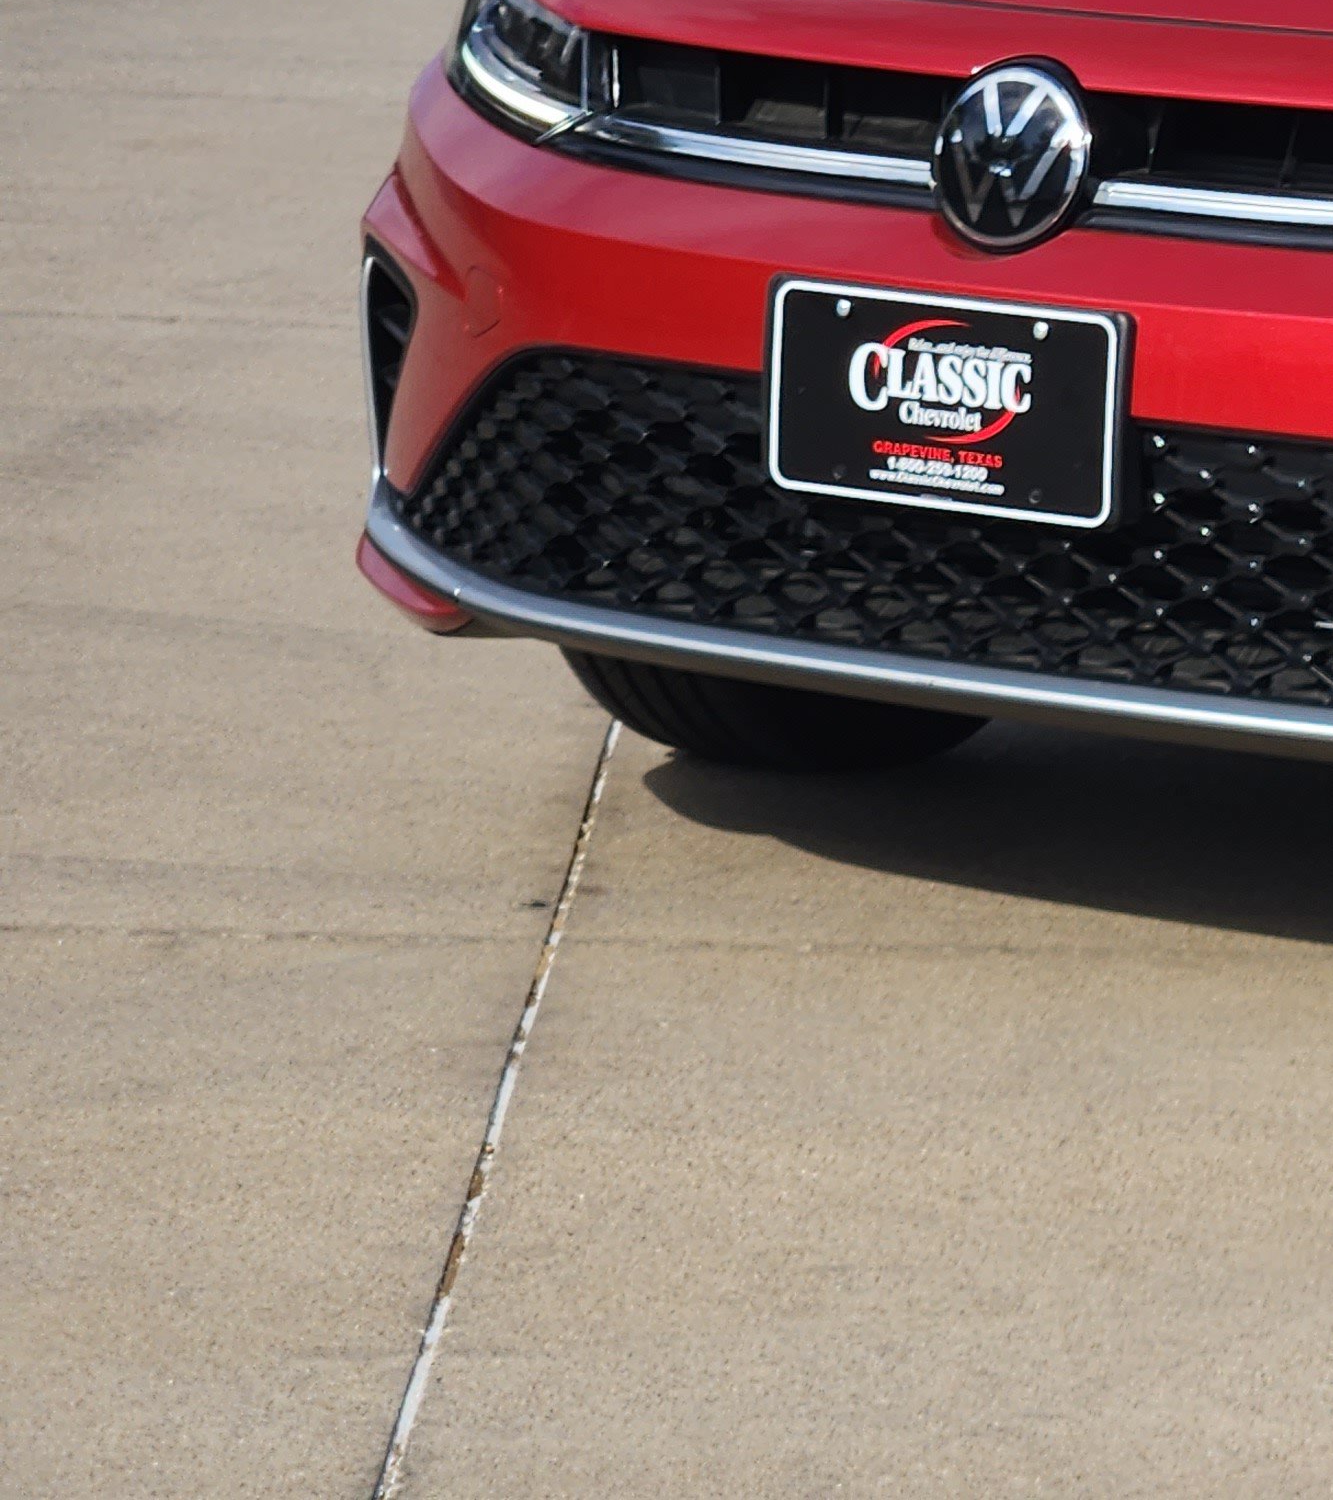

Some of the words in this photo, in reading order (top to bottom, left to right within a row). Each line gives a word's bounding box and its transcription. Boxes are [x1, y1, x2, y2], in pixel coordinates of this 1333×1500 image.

[849, 342, 1032, 414] CLASSIC
[898, 400, 982, 432] Chevrolet
[872, 440, 954, 463] GRAPEVINE,
[957, 450, 1003, 468] TEXAS
